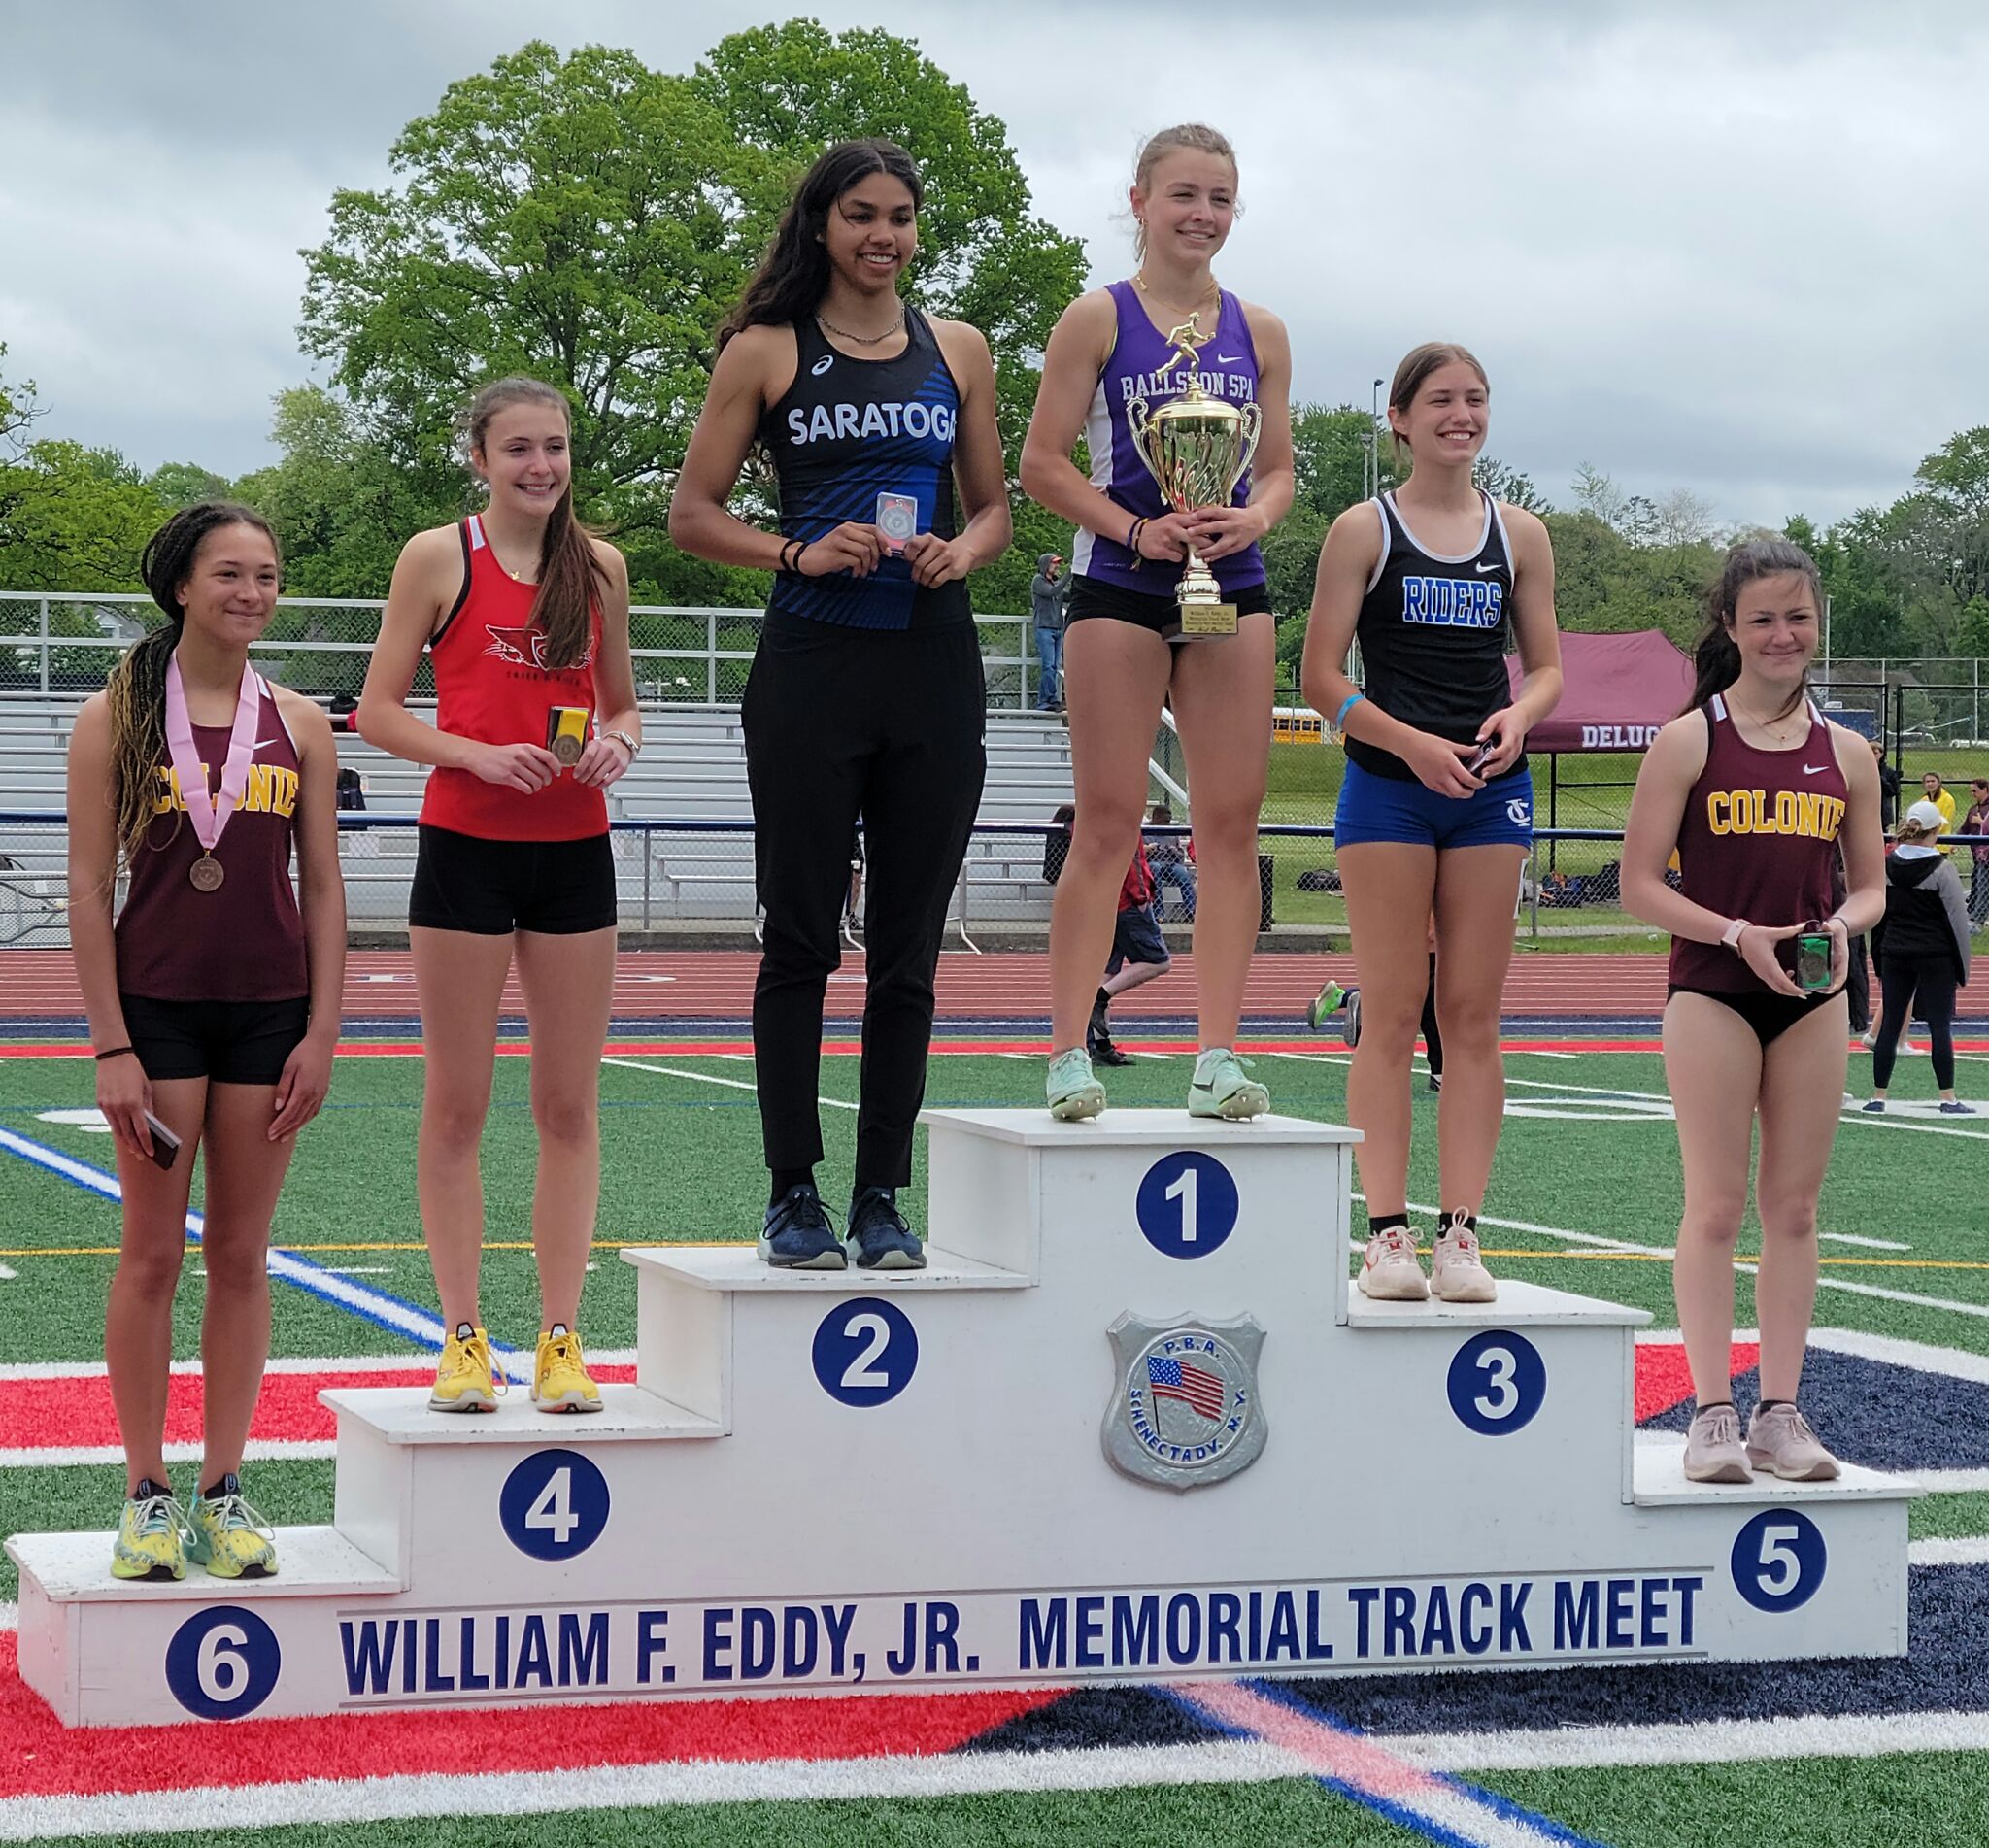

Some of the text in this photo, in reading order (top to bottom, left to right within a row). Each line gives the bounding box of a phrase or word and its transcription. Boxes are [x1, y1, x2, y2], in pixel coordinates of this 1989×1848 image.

[1229, 374, 1254, 401] SPA
[1402, 576, 1502, 628] RIDERS
[1707, 790, 1846, 842] COLONIE
[1166, 1169, 1197, 1240] 1
[841, 1314, 890, 1386] 2
[1163, 1337, 1220, 1359] P.B.A.
[1475, 1348, 1518, 1419] 3
[525, 1468, 578, 1542] 4
[1758, 1527, 1800, 1596] 5
[198, 1625, 249, 1701] 6
[340, 1577, 1703, 1695] WILLIAM F. EDDY, JR. MEMORIAL TRACK MEET
